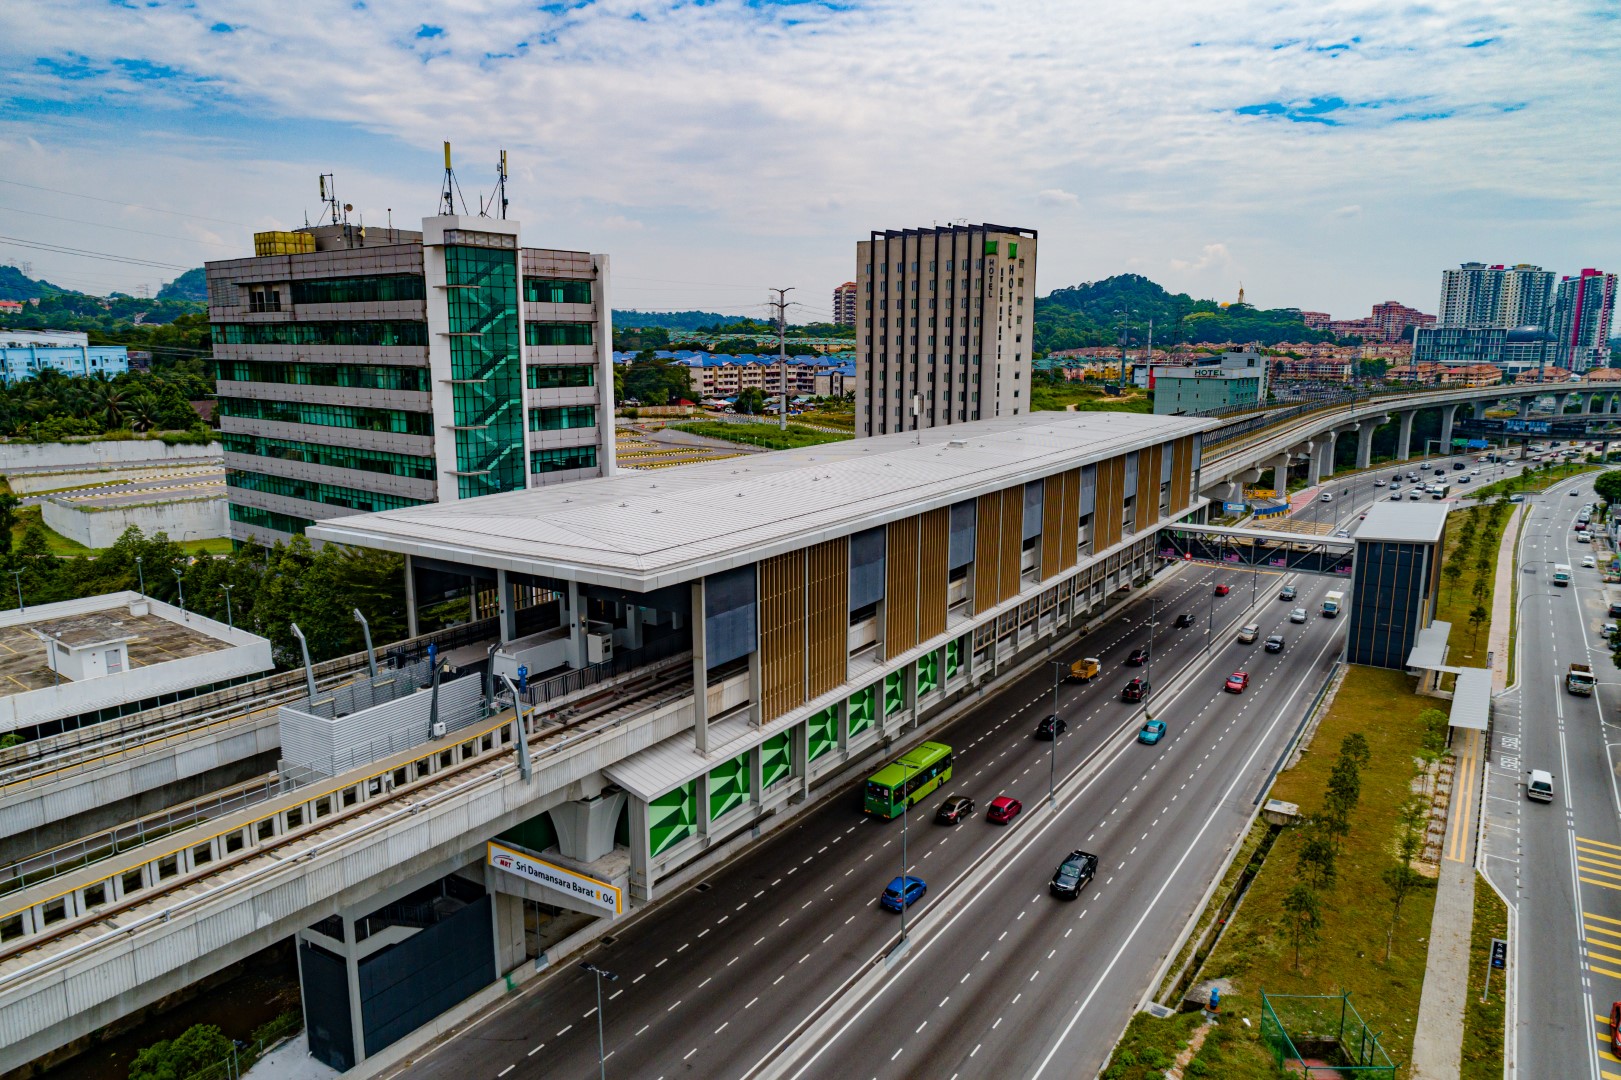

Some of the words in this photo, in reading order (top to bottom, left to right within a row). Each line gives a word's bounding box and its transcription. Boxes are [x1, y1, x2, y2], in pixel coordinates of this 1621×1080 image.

[1194, 369, 1225, 377] HOTEL
[499, 859, 512, 869] MRT
[516, 861, 527, 873] Sri
[528, 865, 571, 889] Damansara
[572, 881, 595, 898] Barat
[602, 893, 614, 905] 06
